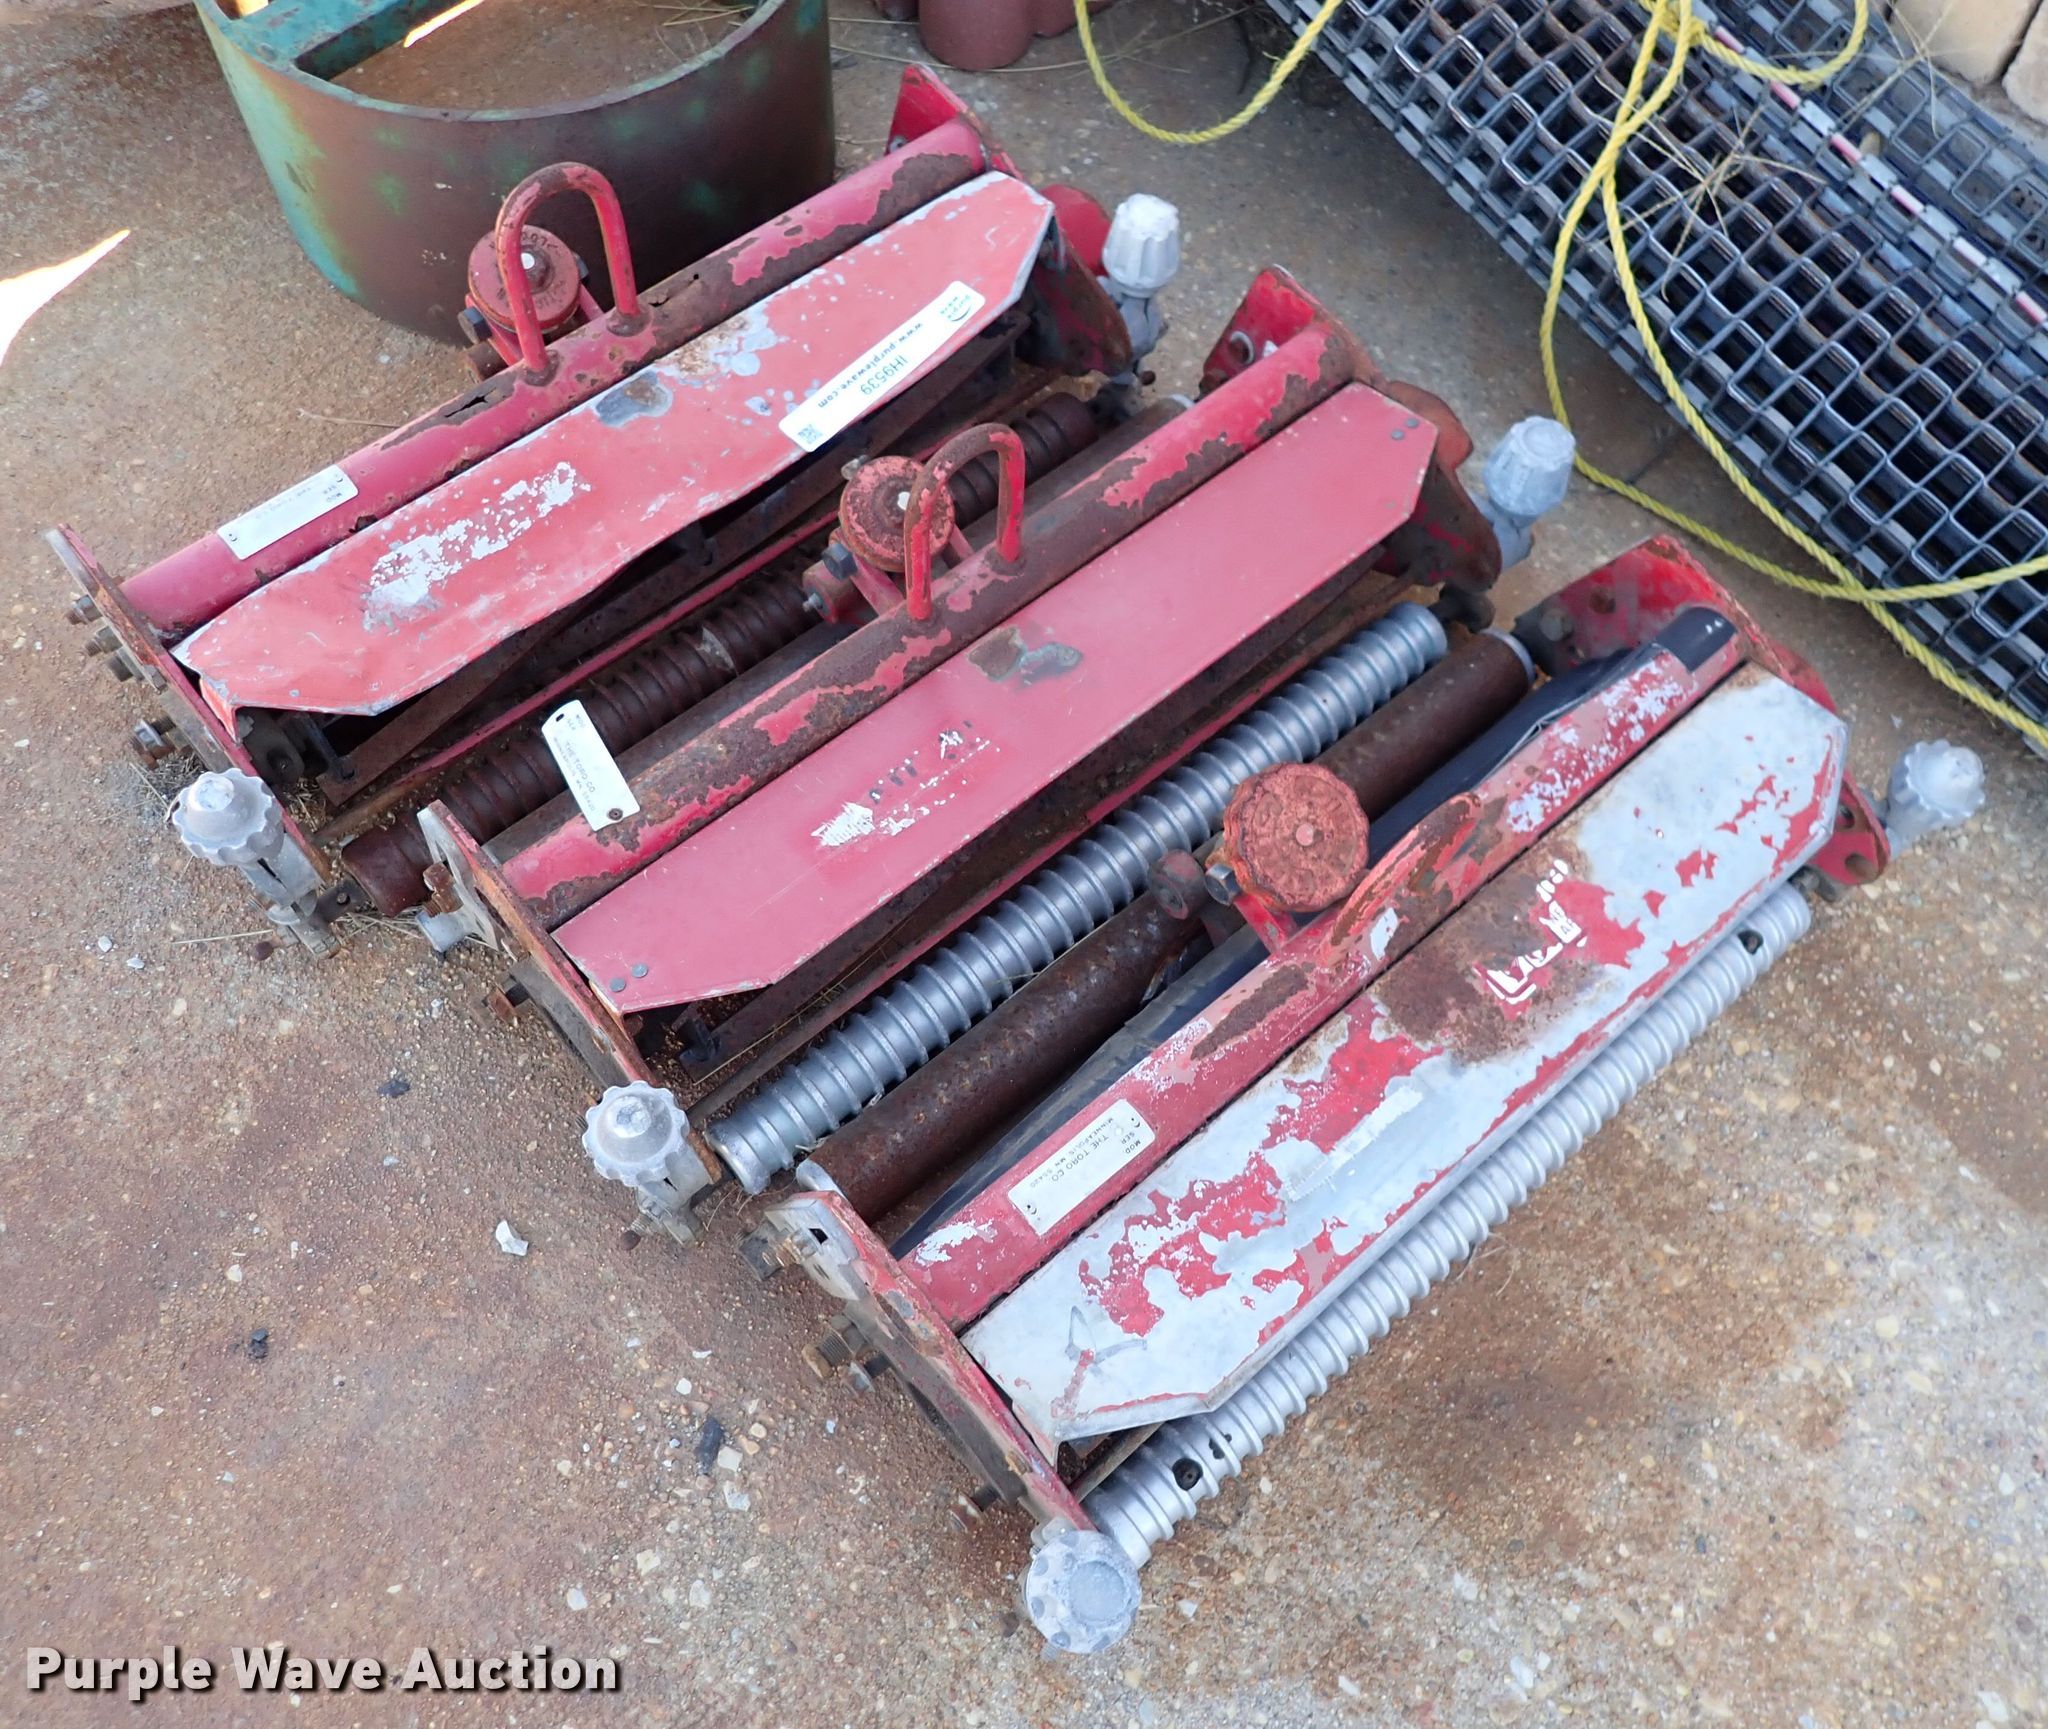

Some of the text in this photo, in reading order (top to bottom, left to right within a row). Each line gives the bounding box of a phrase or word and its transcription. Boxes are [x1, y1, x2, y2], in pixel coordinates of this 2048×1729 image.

[816, 322, 924, 410] www.purplewave.com
[859, 354, 908, 396] IH9539
[563, 741, 575, 757] THE
[573, 758, 589, 780] TORO
[1090, 1133, 1109, 1150] THE
[1065, 1149, 1090, 1171] TORO
[1030, 1168, 1053, 1188] 55420
